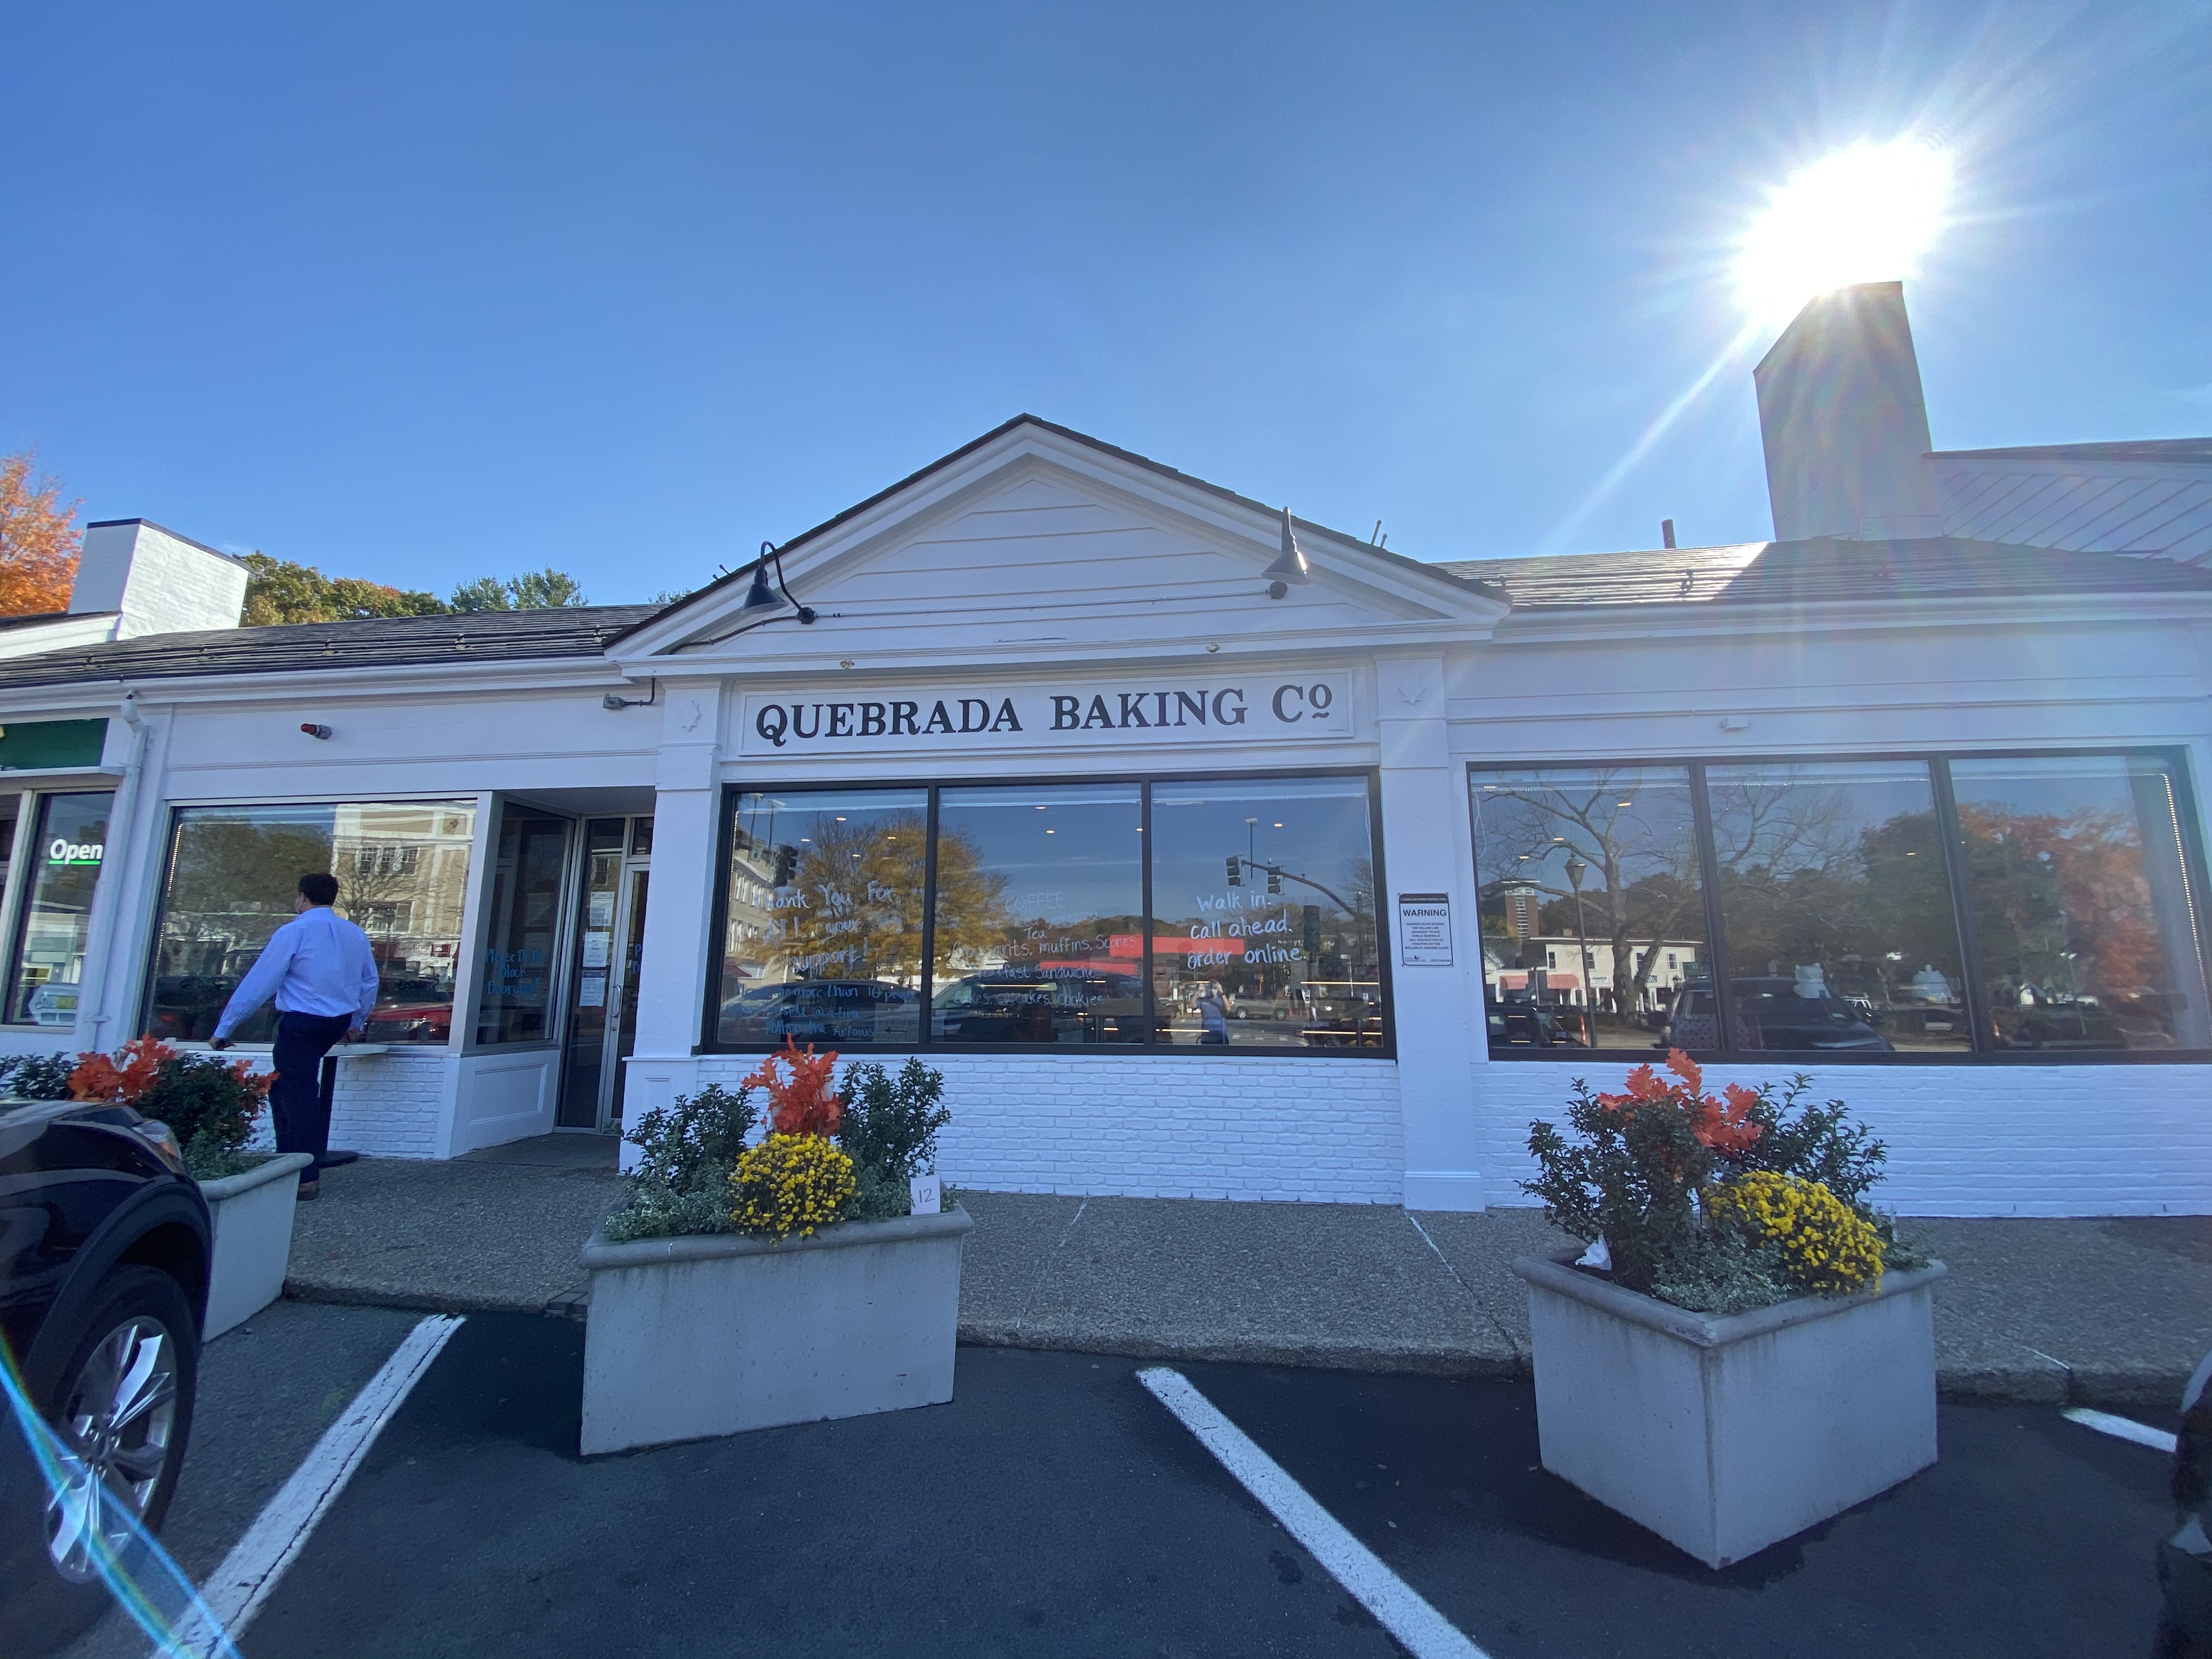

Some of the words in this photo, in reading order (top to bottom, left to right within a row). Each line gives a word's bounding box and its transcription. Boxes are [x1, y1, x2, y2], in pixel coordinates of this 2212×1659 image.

[755, 697, 1024, 748] QUEBRADA
[1049, 688, 1249, 731] BAKING
[49, 838, 103, 864] Open
[817, 881, 854, 907] You
[867, 880, 896, 905] For
[1005, 890, 1068, 913] COFFEE
[816, 918, 862, 947] your
[1024, 927, 1046, 940] Tea
[827, 984, 859, 998] than
[919, 1188, 935, 1203] 12
